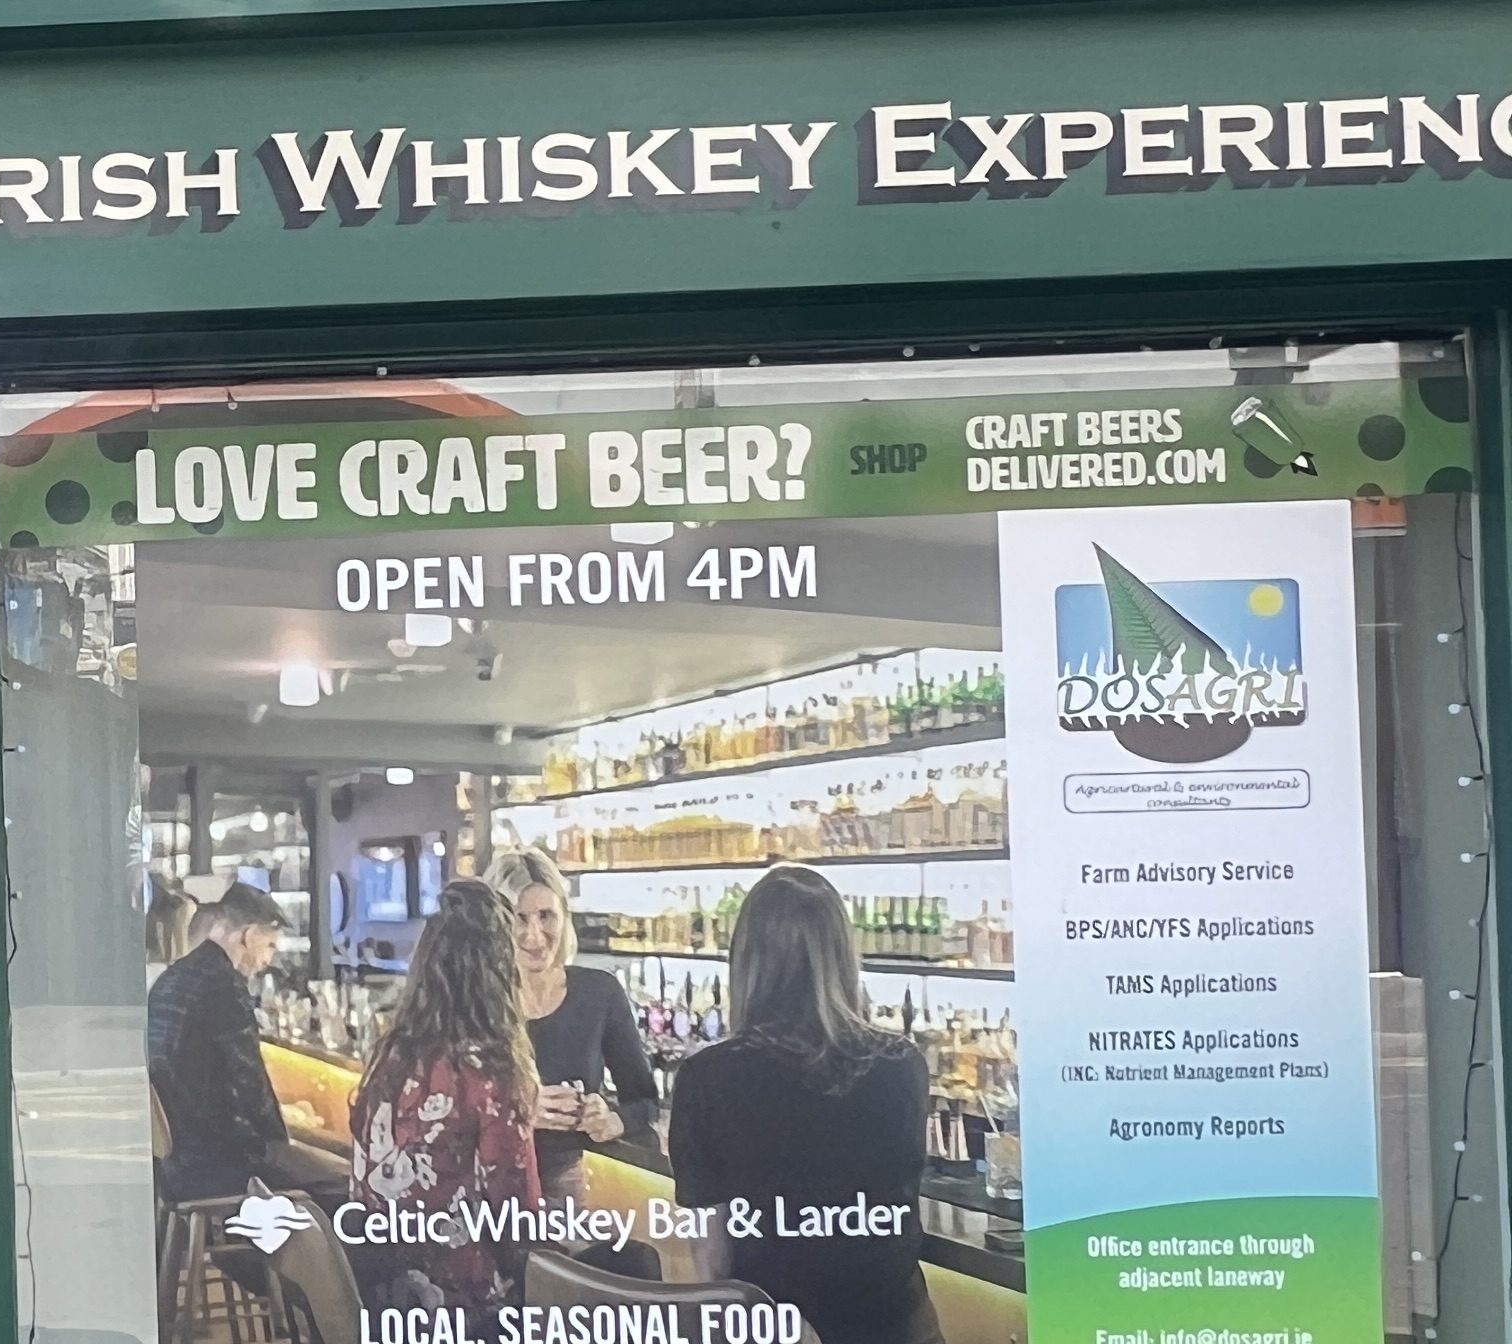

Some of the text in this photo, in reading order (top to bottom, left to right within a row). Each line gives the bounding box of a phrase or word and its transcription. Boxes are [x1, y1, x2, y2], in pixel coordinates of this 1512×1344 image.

[271, 122, 838, 213] WHISKEY
[965, 408, 1184, 451] CRAFT BEERS
[135, 422, 813, 526] LOVE CRAFT BEER?
[849, 442, 928, 476] SHOP
[966, 447, 1228, 493] DELIVERED.COM
[336, 543, 819, 613] OPEN FROM 4PM
[1057, 669, 1304, 716] DOSAGRI
[1081, 860, 1295, 886] Farm Advisory Service
[1065, 914, 1315, 940] BPS/ANC/YFS Applications
[1105, 972, 1278, 998] TAMS Applications
[1088, 1028, 1300, 1054] NITRATES Applications
[1173, 1062, 1275, 1084] Management
[1109, 1115, 1286, 1142] Agronomy Reports
[331, 1191, 912, 1253] Celtic Whiskey Bar & Larder
[1087, 1233, 1316, 1259] Office entrance through
[1118, 1266, 1286, 1291] adjacent laneway
